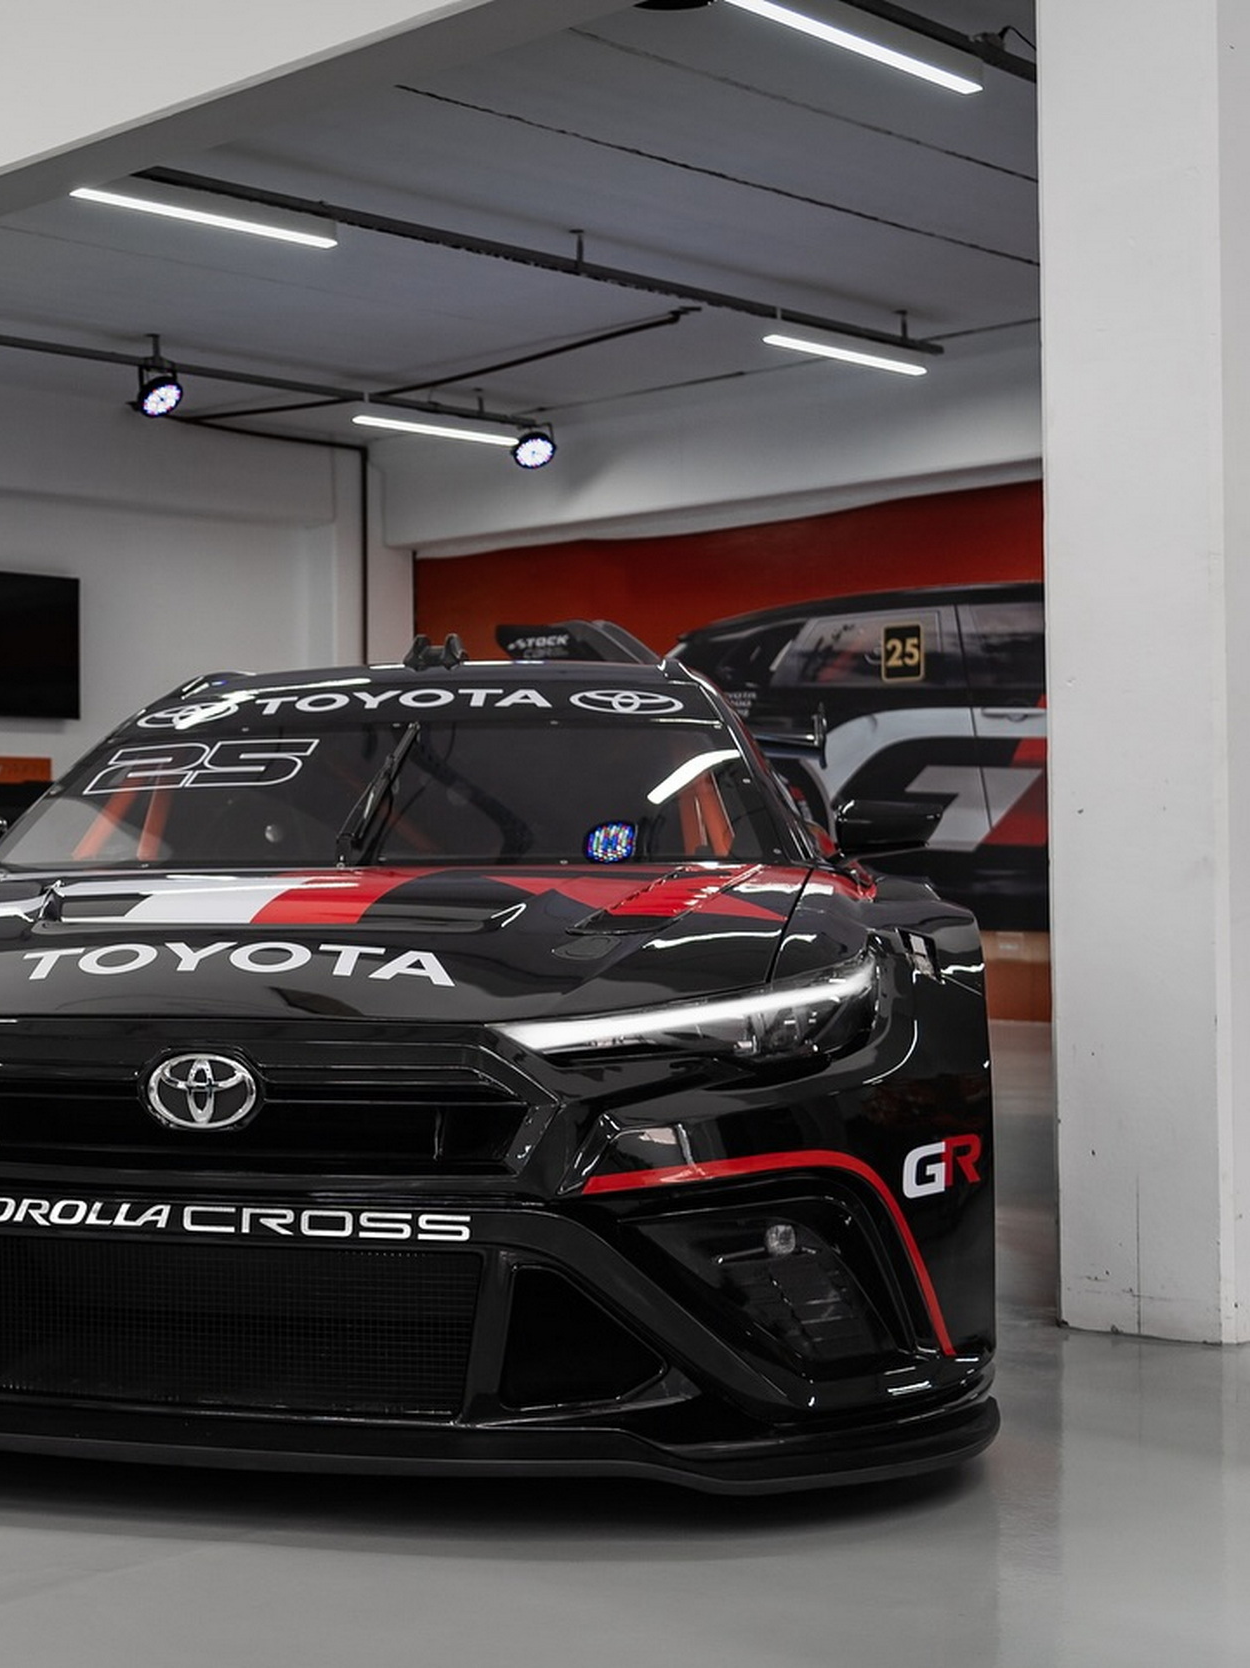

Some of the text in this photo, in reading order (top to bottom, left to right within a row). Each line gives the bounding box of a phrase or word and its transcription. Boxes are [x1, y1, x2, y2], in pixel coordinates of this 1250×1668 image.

[516, 634, 569, 650] STOCK
[886, 637, 919, 667] 25
[255, 688, 553, 715] TOYOTA
[83, 738, 320, 796] 25
[23, 941, 455, 987] TOYOTA
[903, 1133, 981, 1199] GR
[182, 1205, 471, 1242] CROSS
